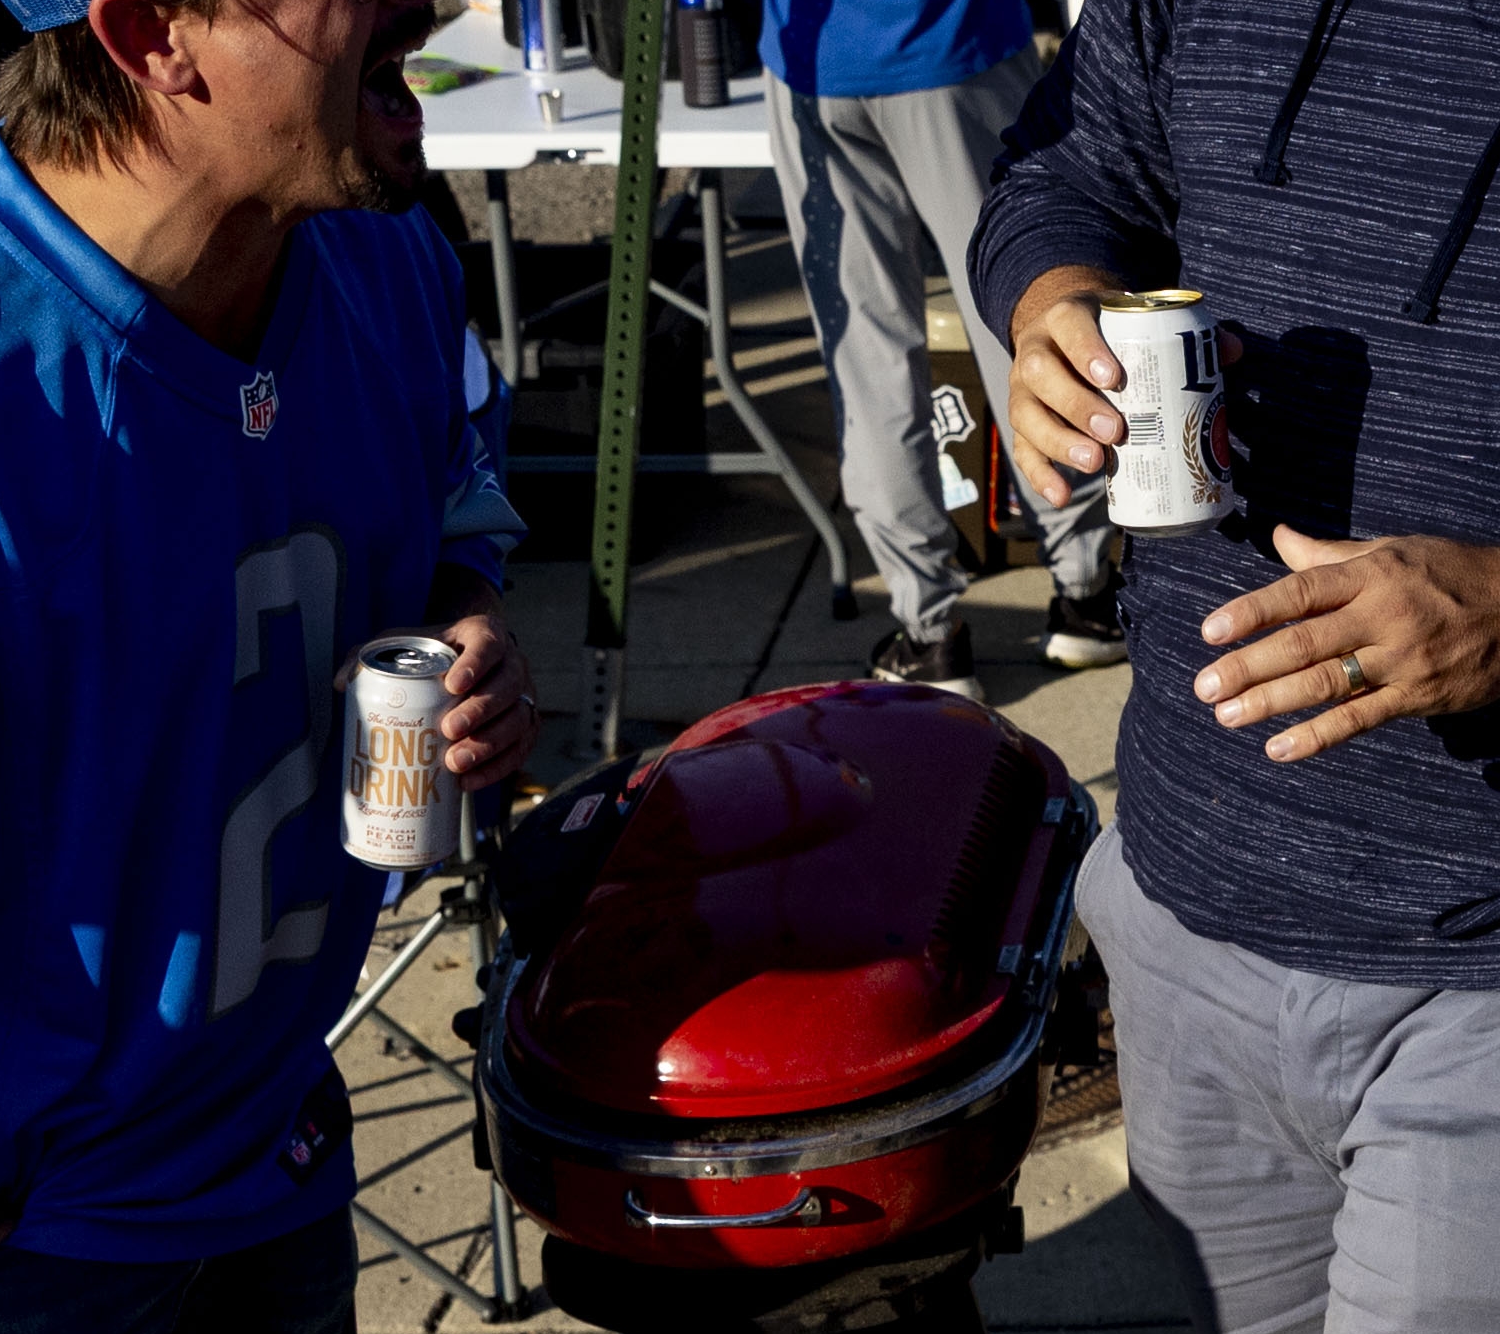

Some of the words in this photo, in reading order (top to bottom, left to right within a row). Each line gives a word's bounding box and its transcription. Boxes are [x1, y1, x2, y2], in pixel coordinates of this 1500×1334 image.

[1175, 325, 1219, 394] Li
[250, 396, 276, 430] NFL
[356, 719, 438, 766] LONG
[208, 523, 350, 1025] 2
[351, 757, 441, 806] DRINK
[367, 830, 416, 842] PEACH
